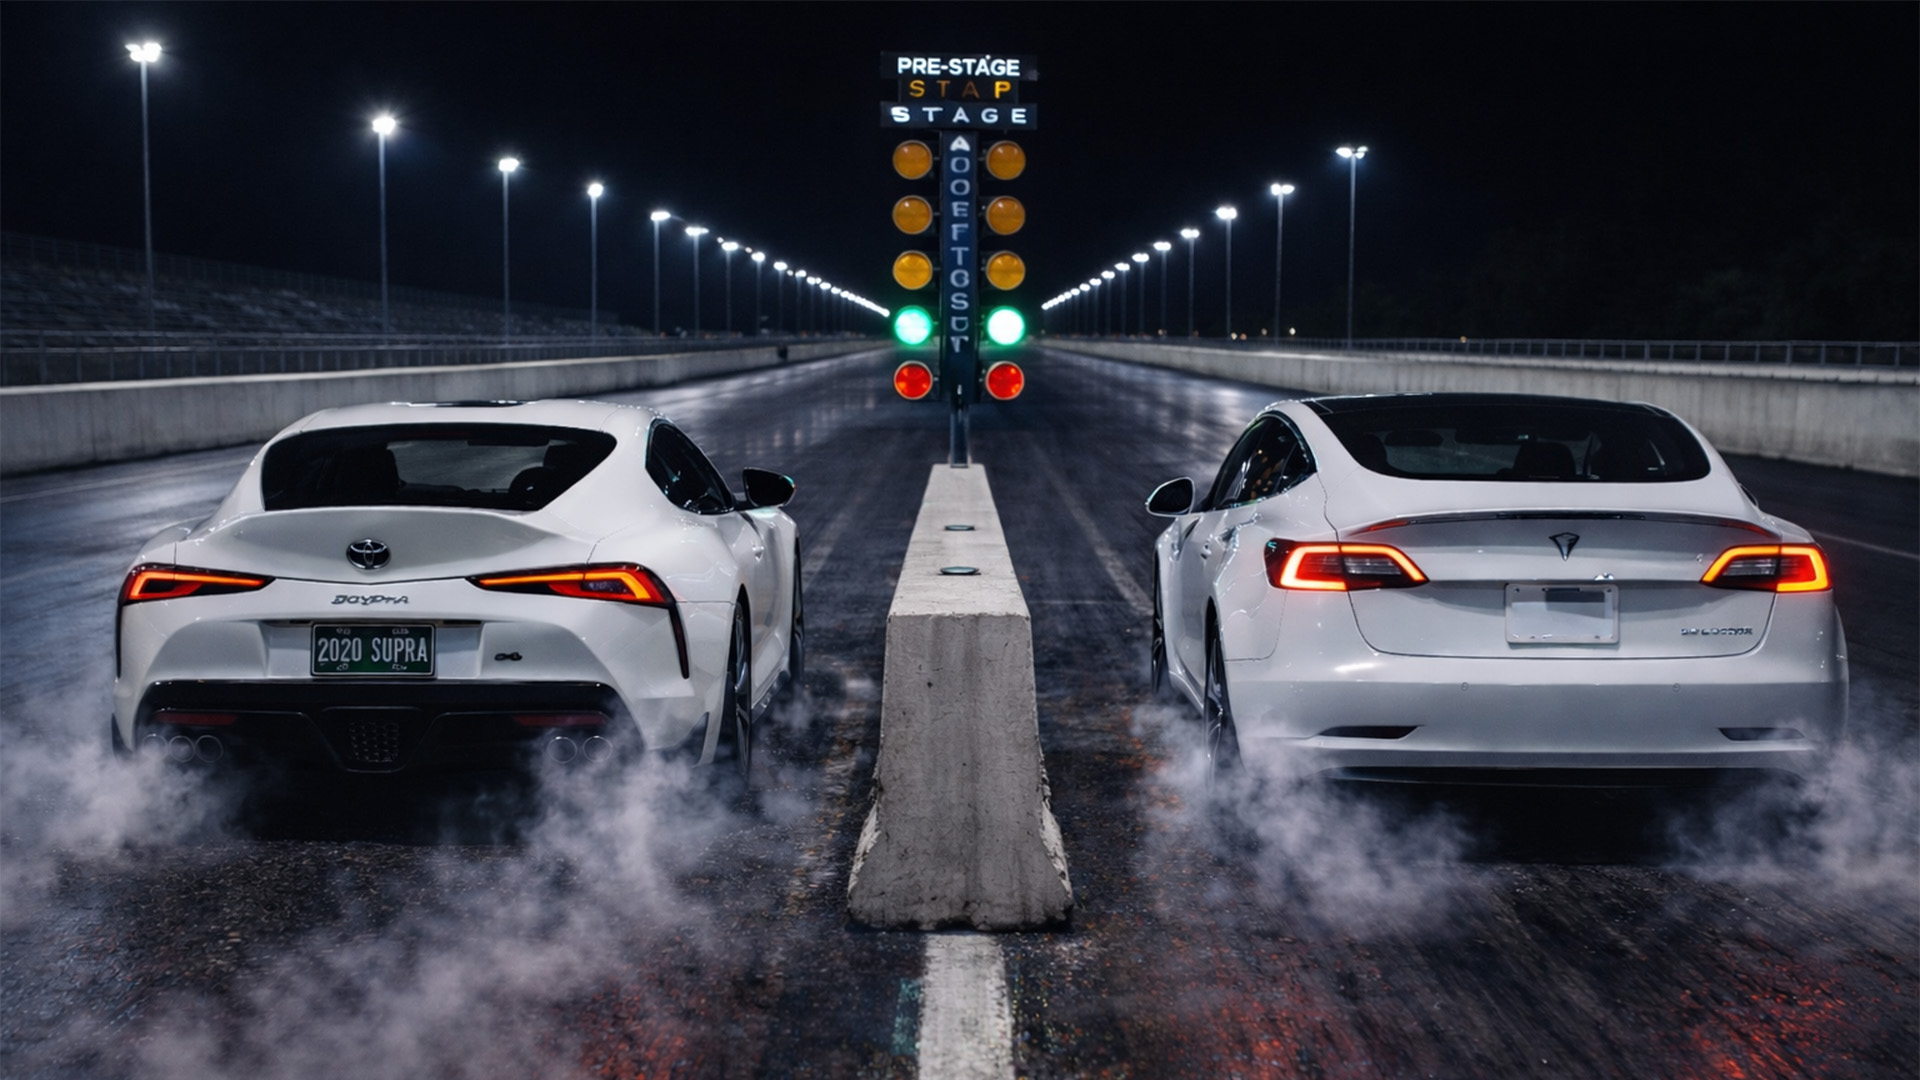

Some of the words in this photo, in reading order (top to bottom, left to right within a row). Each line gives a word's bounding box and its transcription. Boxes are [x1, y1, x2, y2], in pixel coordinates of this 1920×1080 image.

[909, 79, 1012, 99] STAP
[890, 106, 1027, 124] STAGE
[317, 637, 362, 663] 2020
[371, 637, 428, 663] SUPRA
